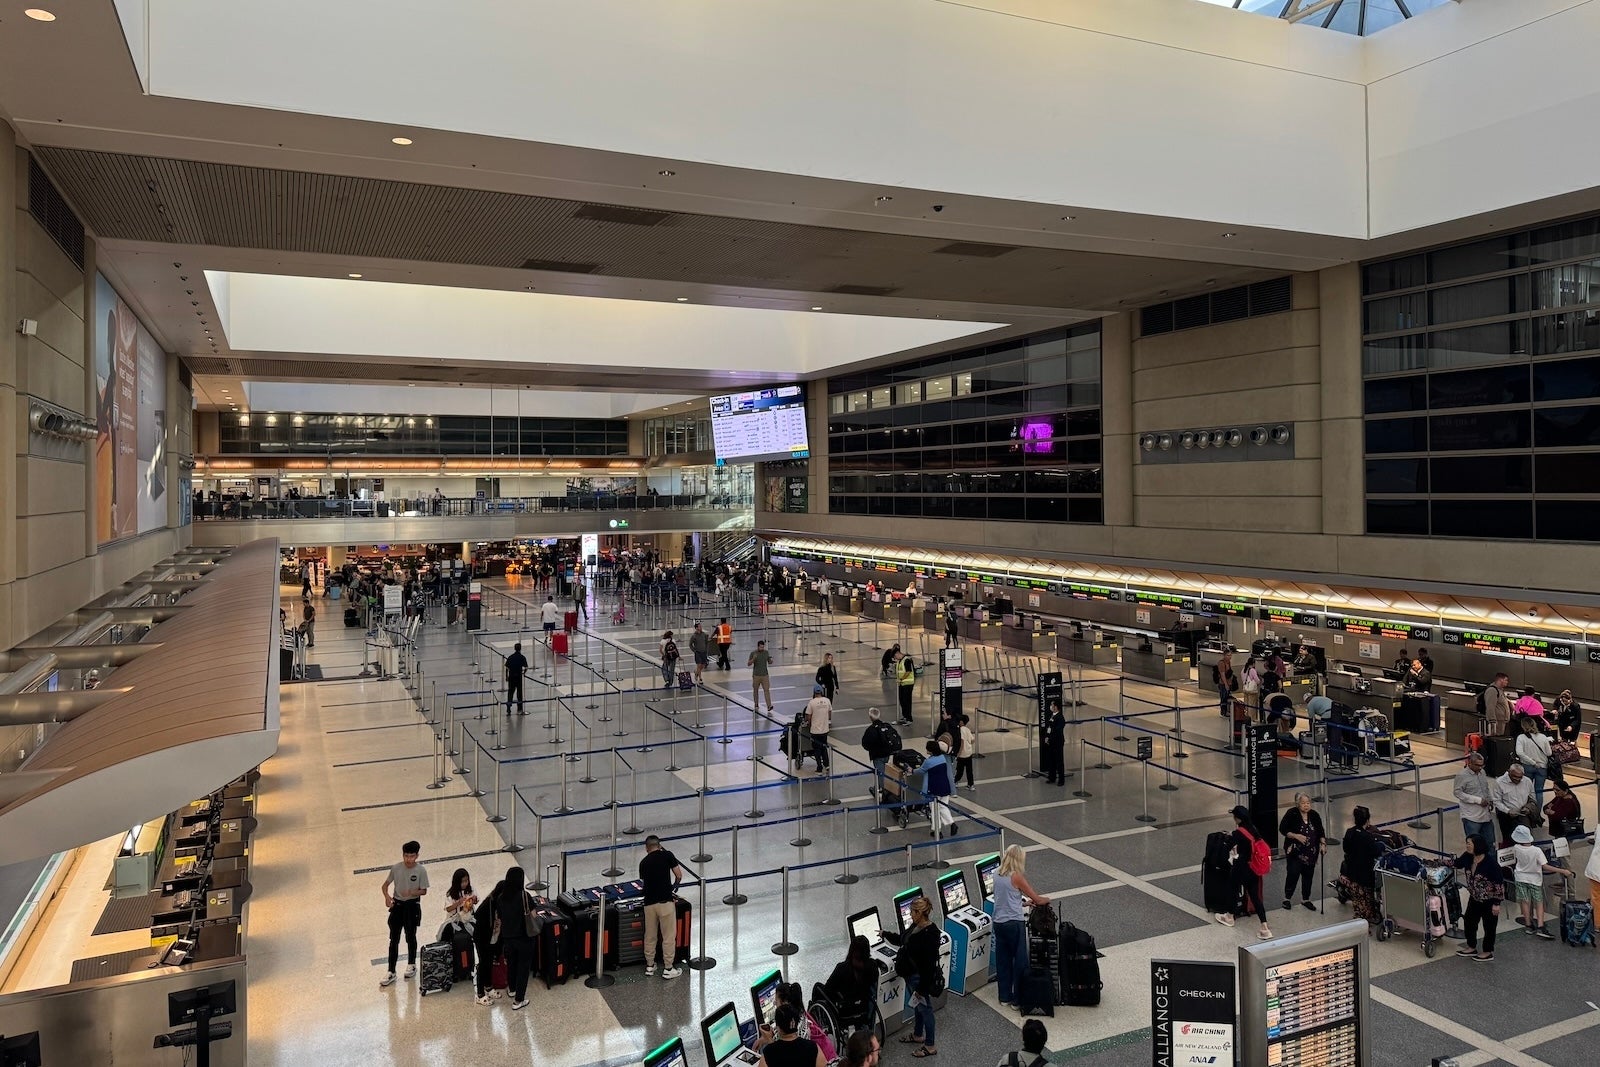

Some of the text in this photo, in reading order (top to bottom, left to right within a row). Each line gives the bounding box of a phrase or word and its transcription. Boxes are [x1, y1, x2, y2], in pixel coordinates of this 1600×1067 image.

[1327, 620, 1339, 628] C41
[1414, 630, 1428, 638] C40
[1444, 633, 1458, 642] C39
[1527, 640, 1548, 648] ZEALAND
[1553, 647, 1570, 656] C38
[971, 944, 985, 960] LAX
[1334, 951, 1353, 959] COUNTERS
[1268, 968, 1279, 978] LAX
[883, 985, 900, 1004] LAX
[1179, 989, 1226, 999] CHECK-IN
[1156, 985, 1169, 1067] ALLIANCE
